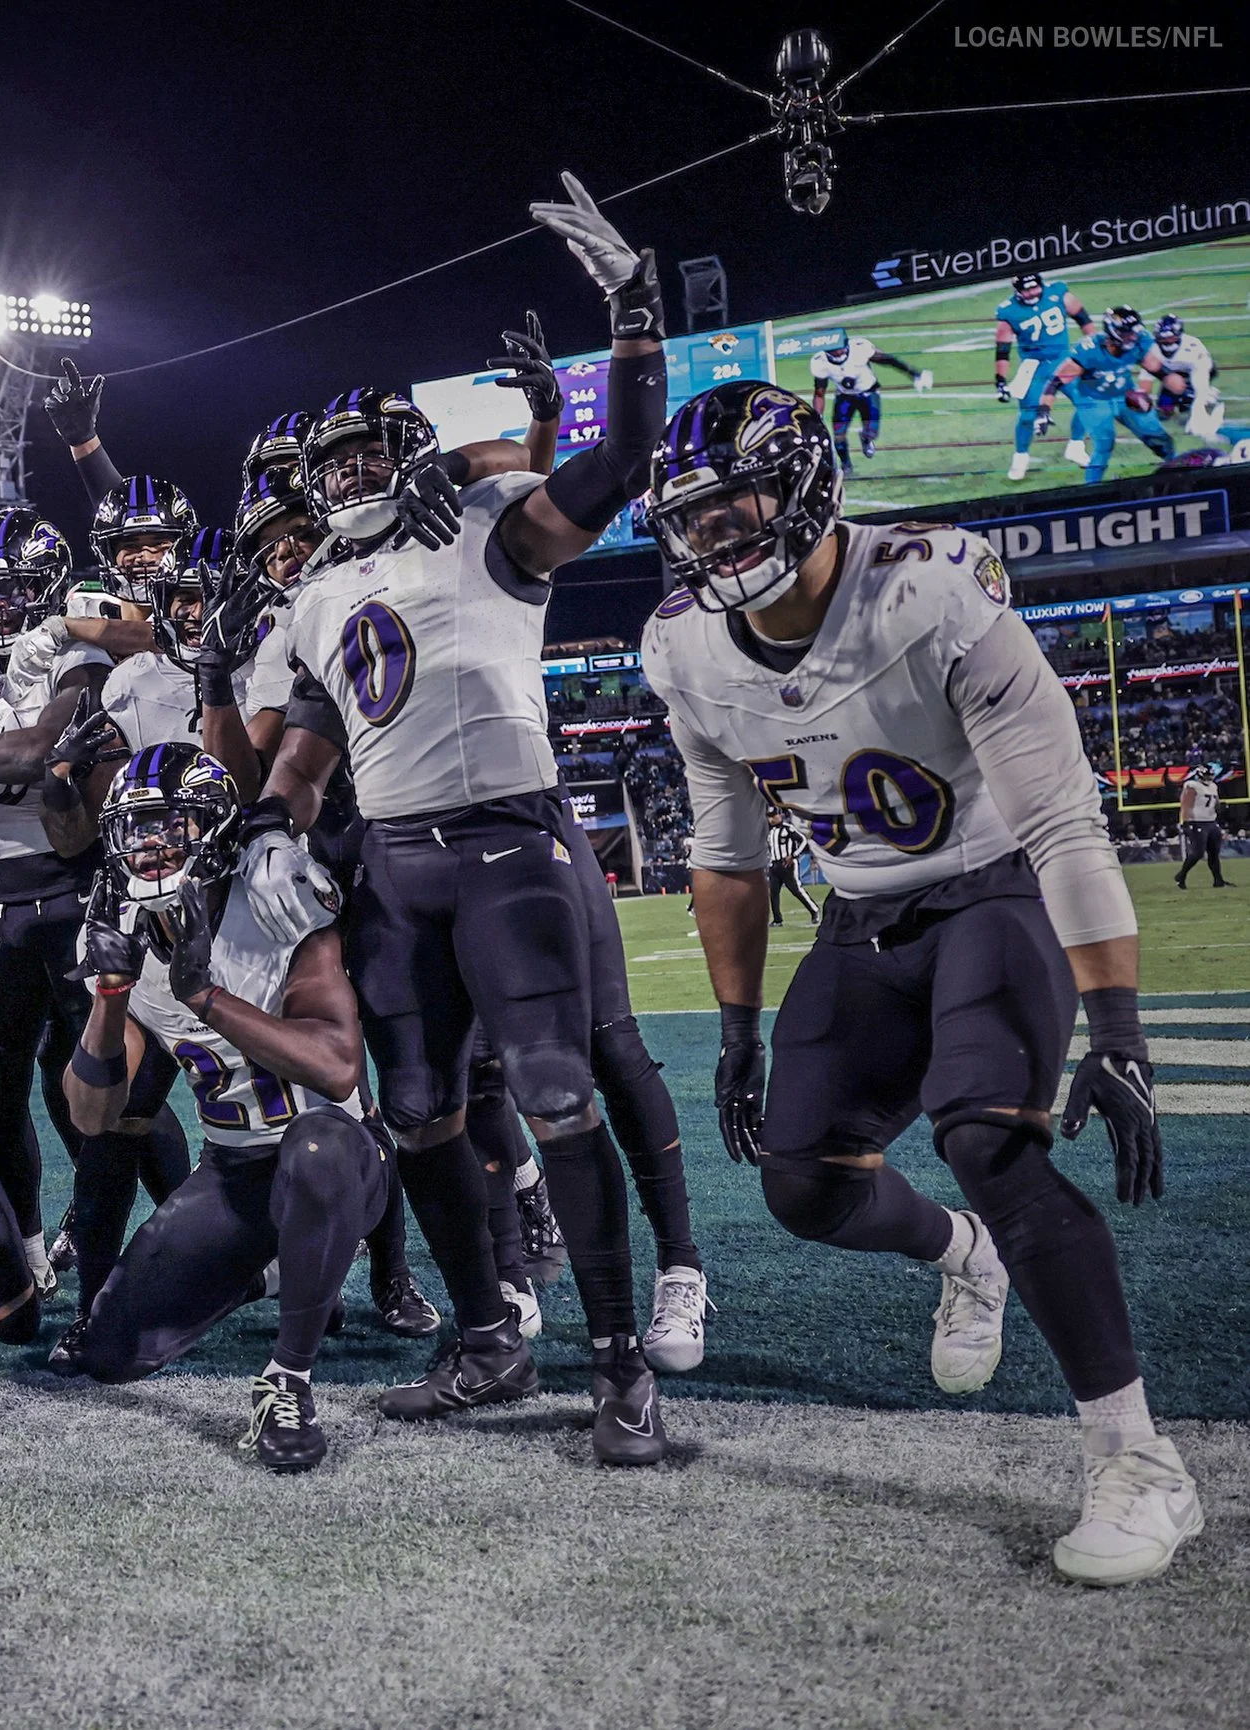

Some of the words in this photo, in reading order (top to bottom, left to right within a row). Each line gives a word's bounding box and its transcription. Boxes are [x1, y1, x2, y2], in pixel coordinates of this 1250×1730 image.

[911, 225, 1082, 283] EverBank
[1090, 199, 1250, 250] Stadium
[1019, 306, 1065, 342] 79
[569, 425, 601, 443] 5.97
[974, 525, 1042, 560] UD
[1050, 502, 1210, 554] LIGHT
[350, 586, 389, 611] RAVENS
[1025, 605, 1074, 621] LUXURY
[1075, 602, 1105, 617] NOW
[340, 600, 417, 728] 0
[784, 733, 839, 747] RAVENS
[745, 748, 957, 856] 50
